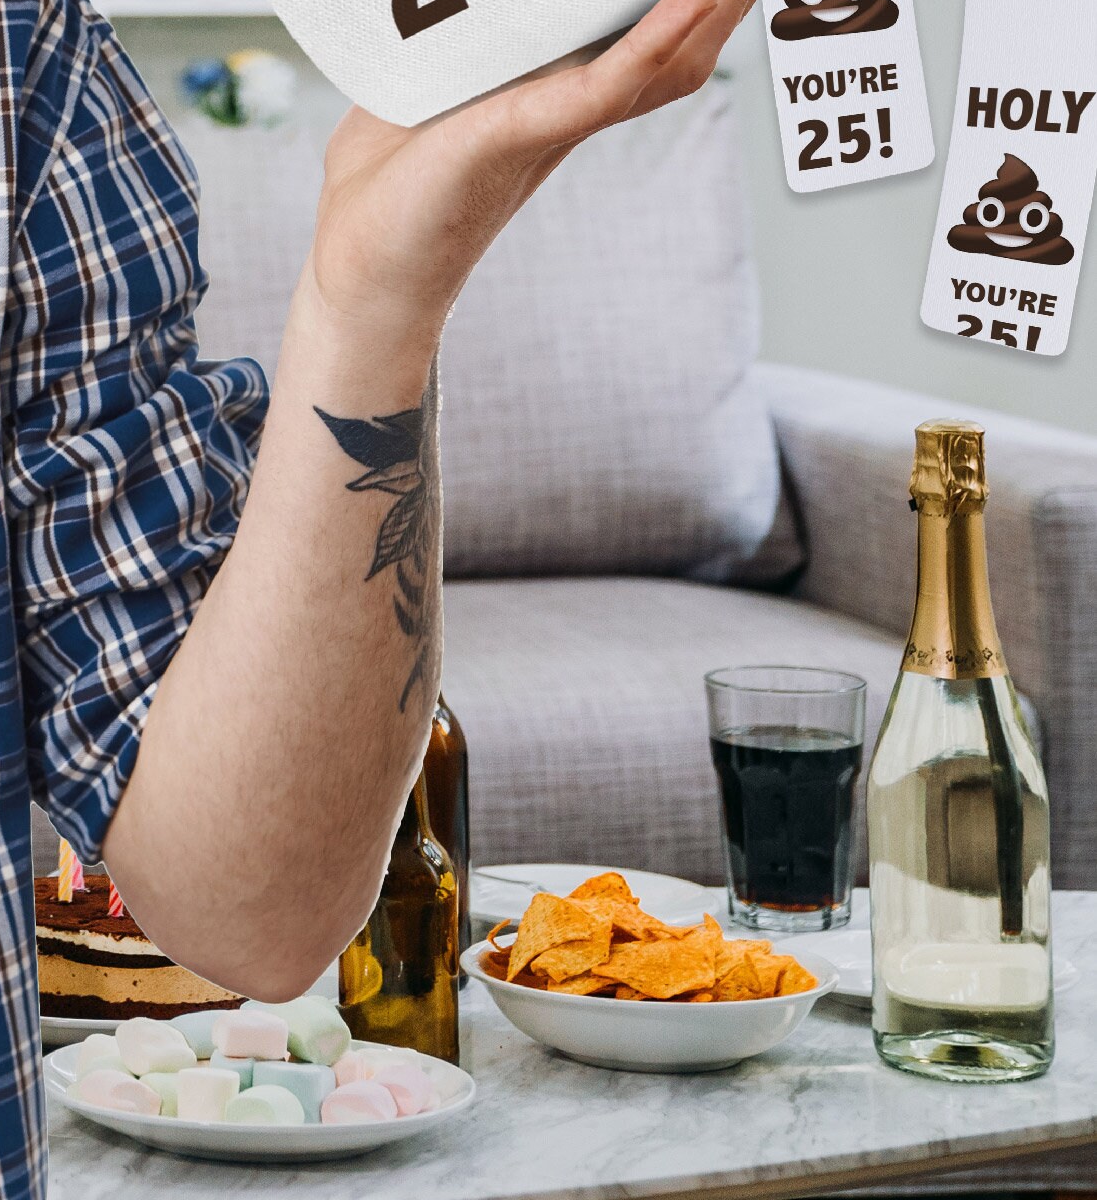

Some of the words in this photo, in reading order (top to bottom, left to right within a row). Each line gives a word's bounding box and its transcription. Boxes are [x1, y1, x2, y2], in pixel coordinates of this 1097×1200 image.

[782, 64, 898, 103] YOU'RE
[967, 87, 1096, 133] HOLY
[798, 108, 893, 171] 25!
[951, 278, 1058, 317] YOU'RE
